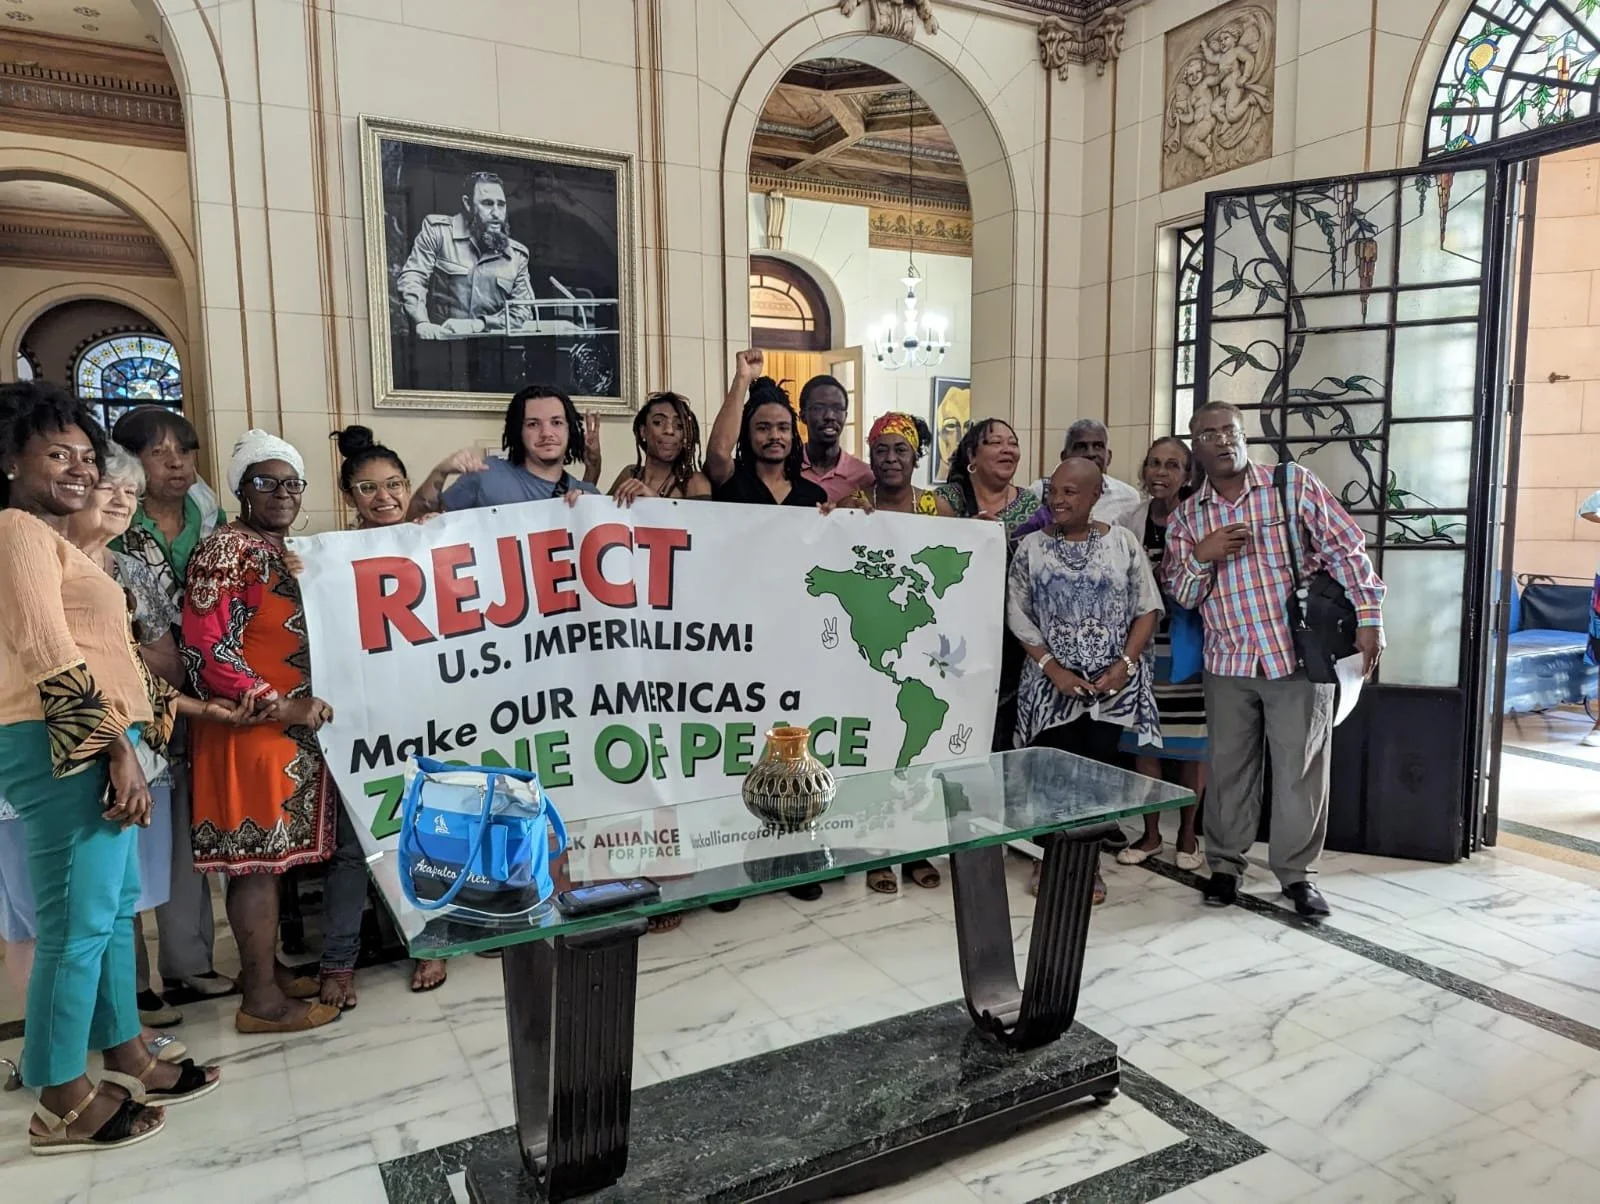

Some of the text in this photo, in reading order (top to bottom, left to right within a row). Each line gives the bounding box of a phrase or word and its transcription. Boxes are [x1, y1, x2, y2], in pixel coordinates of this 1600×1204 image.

[352, 523, 691, 655] REJECT
[438, 618, 753, 684] U.S. IMPERIALISM!
[350, 681, 800, 773] Make OUR AMERICAS a
[364, 730, 573, 840] ZNE
[594, 722, 669, 784] OF
[414, 858, 457, 879] Acapulco
[593, 828, 680, 849] ALLIANCE
[608, 844, 681, 861] FOR PEACE
